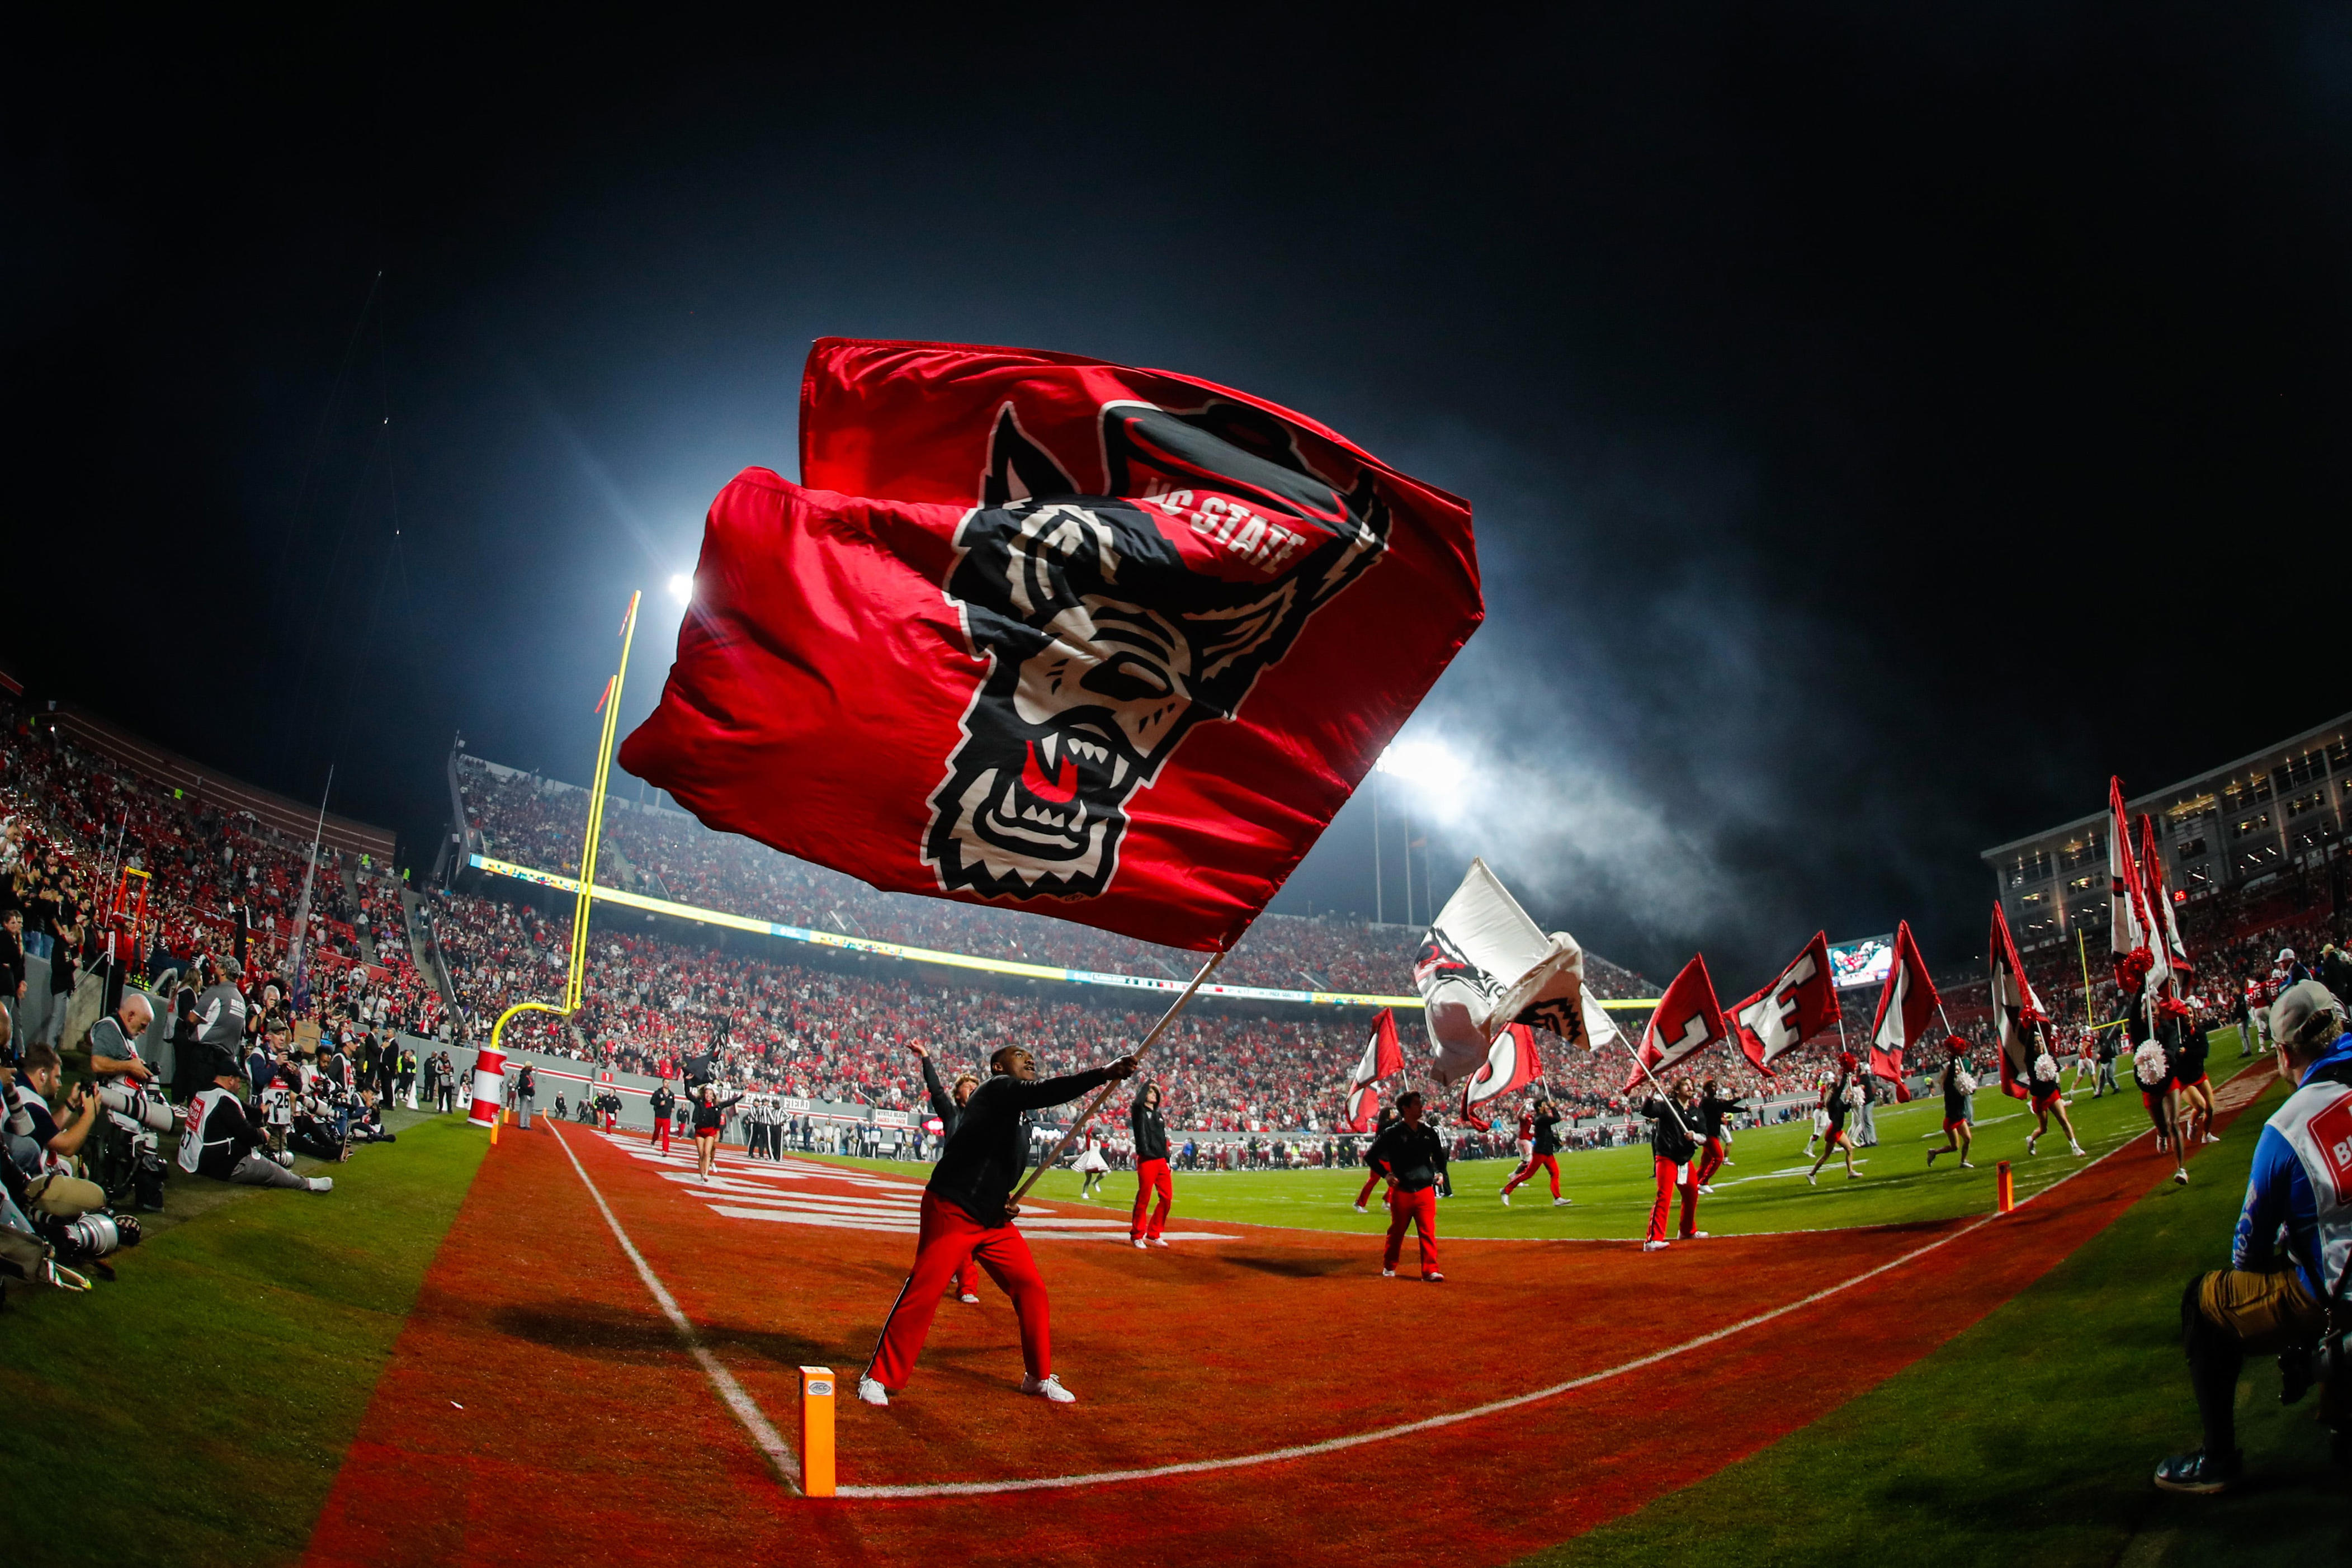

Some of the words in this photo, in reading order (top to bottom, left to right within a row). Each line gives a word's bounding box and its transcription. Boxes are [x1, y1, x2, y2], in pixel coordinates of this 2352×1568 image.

[1141, 478, 1192, 515] NC
[1190, 497, 1307, 574] STATE
[2174, 891, 2184, 900] 25
[1739, 953, 1817, 1067] F
[275, 1092, 290, 1108] 26
[783, 1097, 810, 1109] FIELD
